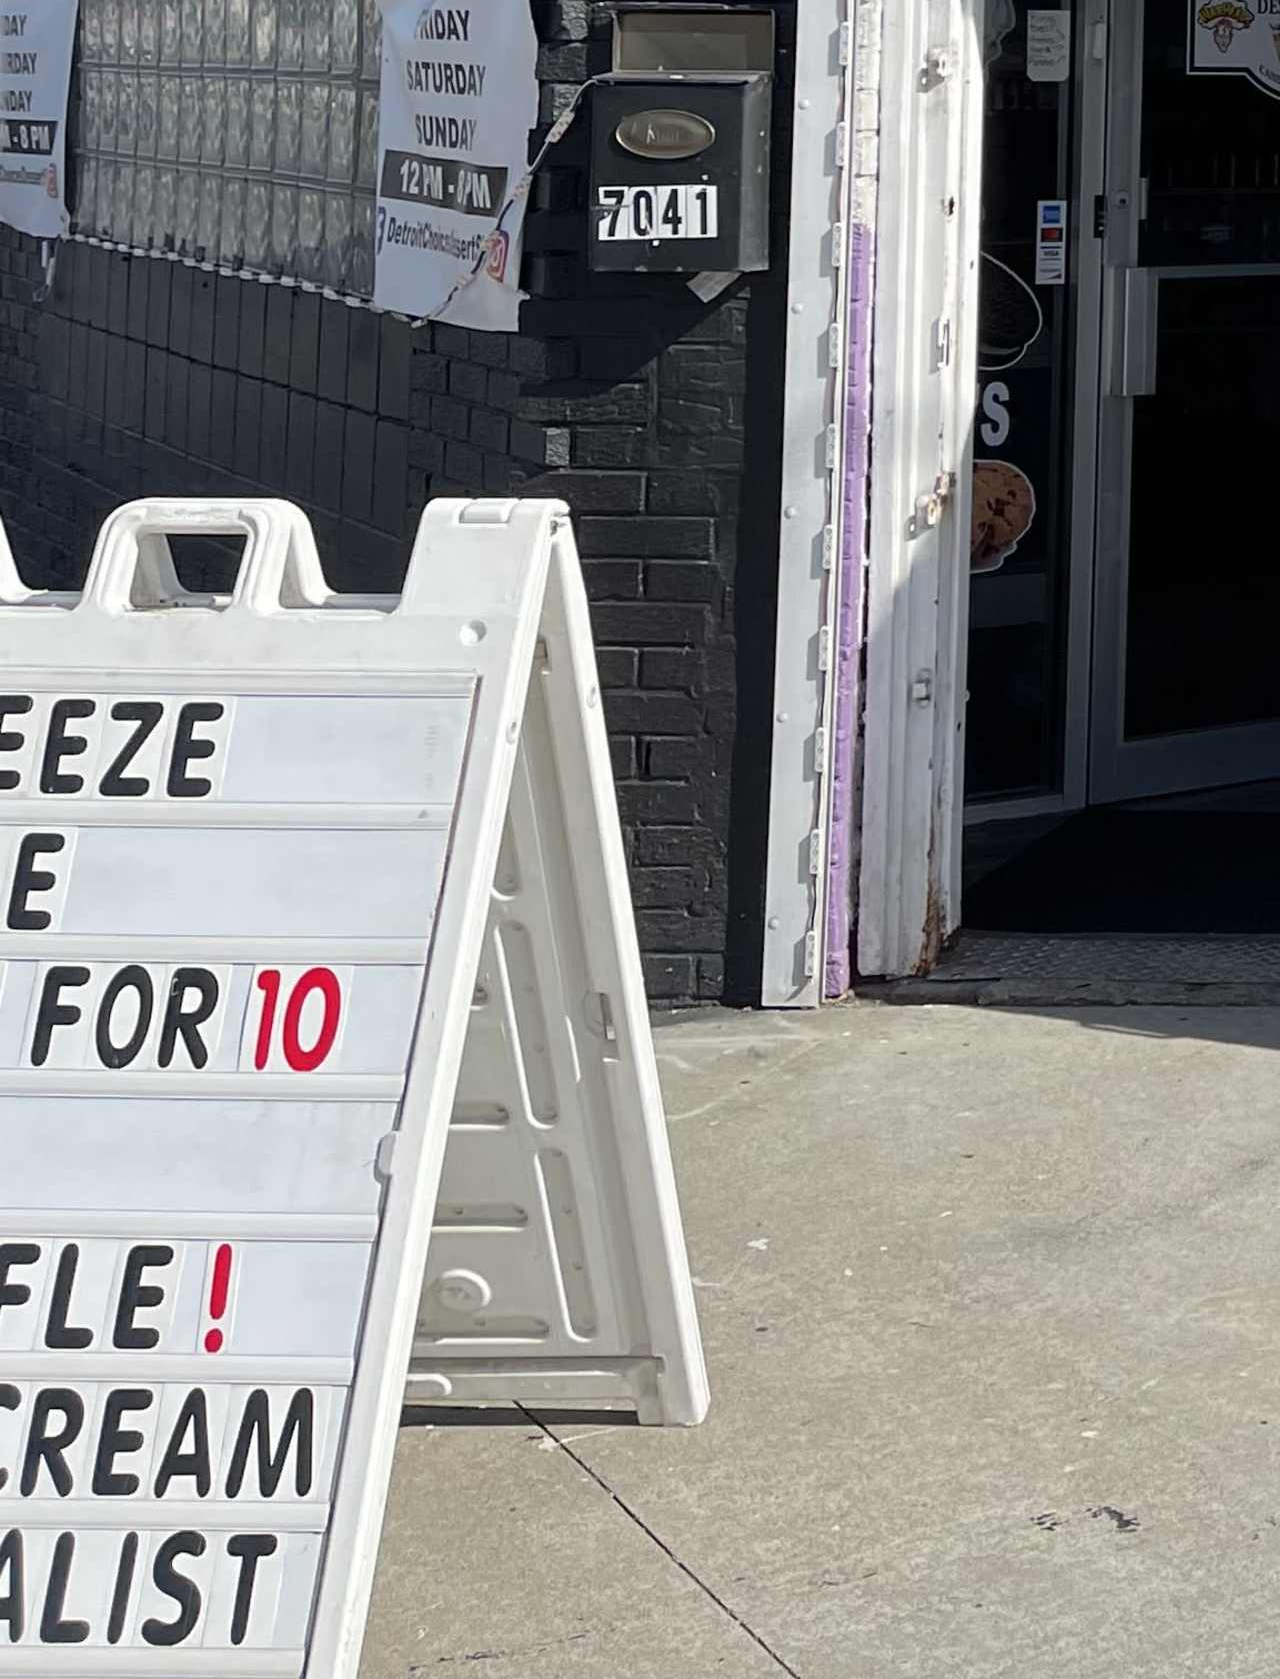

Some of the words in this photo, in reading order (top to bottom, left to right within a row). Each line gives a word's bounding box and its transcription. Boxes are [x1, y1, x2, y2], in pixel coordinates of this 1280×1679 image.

[406, 59, 486, 97] SATURDAY
[415, 114, 477, 152] SUNDAY
[399, 159, 419, 196] 12
[603, 188, 709, 238] 7041
[30, 964, 219, 1069] FOR
[254, 967, 342, 1073] 10
